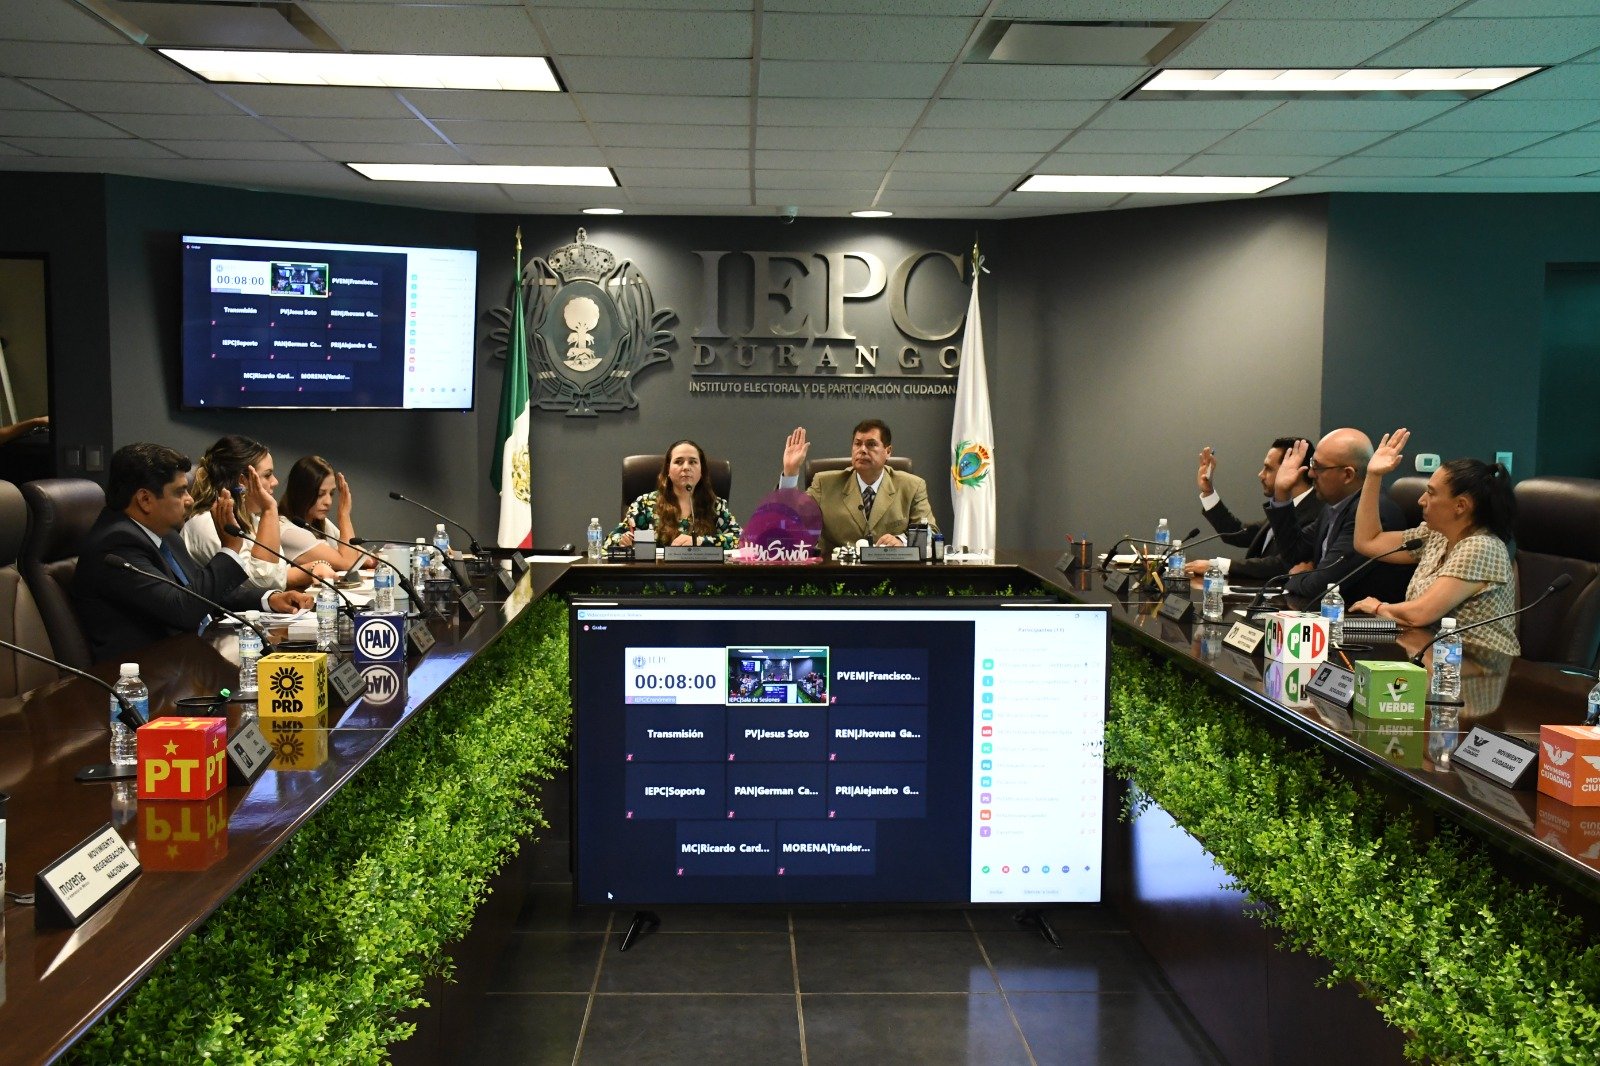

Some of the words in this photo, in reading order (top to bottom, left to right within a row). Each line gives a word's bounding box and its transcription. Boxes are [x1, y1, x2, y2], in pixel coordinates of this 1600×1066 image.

[216, 275, 265, 286] 00:08:00
[691, 250, 966, 341] IEPC
[693, 344, 961, 369] DURANGO
[689, 381, 742, 393] INSTITUTO
[744, 382, 801, 394] ELECTORAL
[802, 384, 809, 393] Y
[811, 384, 826, 394] DE
[828, 382, 901, 395] PARTICIPACIÓN
[903, 384, 959, 395] CIUDADAN
[365, 630, 391, 648] PAN
[1291, 626, 1321, 652] PRI
[635, 674, 716, 689] 00:08:00
[272, 700, 303, 713] PRD
[1379, 702, 1414, 713] VERDE
[647, 728, 704, 739] Transmisión
[745, 729, 786, 740] PV|Jesus
[788, 729, 809, 739] Soto
[1497, 748, 1523, 764] MOVIMIENTO
[206, 750, 225, 791] PT
[1491, 757, 1515, 772] CIUDADANO
[1543, 763, 1571, 779] MOVIMIENTO
[145, 759, 200, 793] PT
[1540, 769, 1572, 789] CIUDADANO
[645, 786, 706, 797] IEPC|Soporte
[734, 786, 794, 797] PAN|German
[88, 837, 115, 859] MOVIMIENTO
[681, 843, 736, 854] MC|Ricardo
[783, 843, 870, 854] MORENA|Yander...
[93, 846, 126, 873] REGENERACIÓN
[107, 860, 129, 880] NACIONAL
[58, 871, 87, 896] morena
